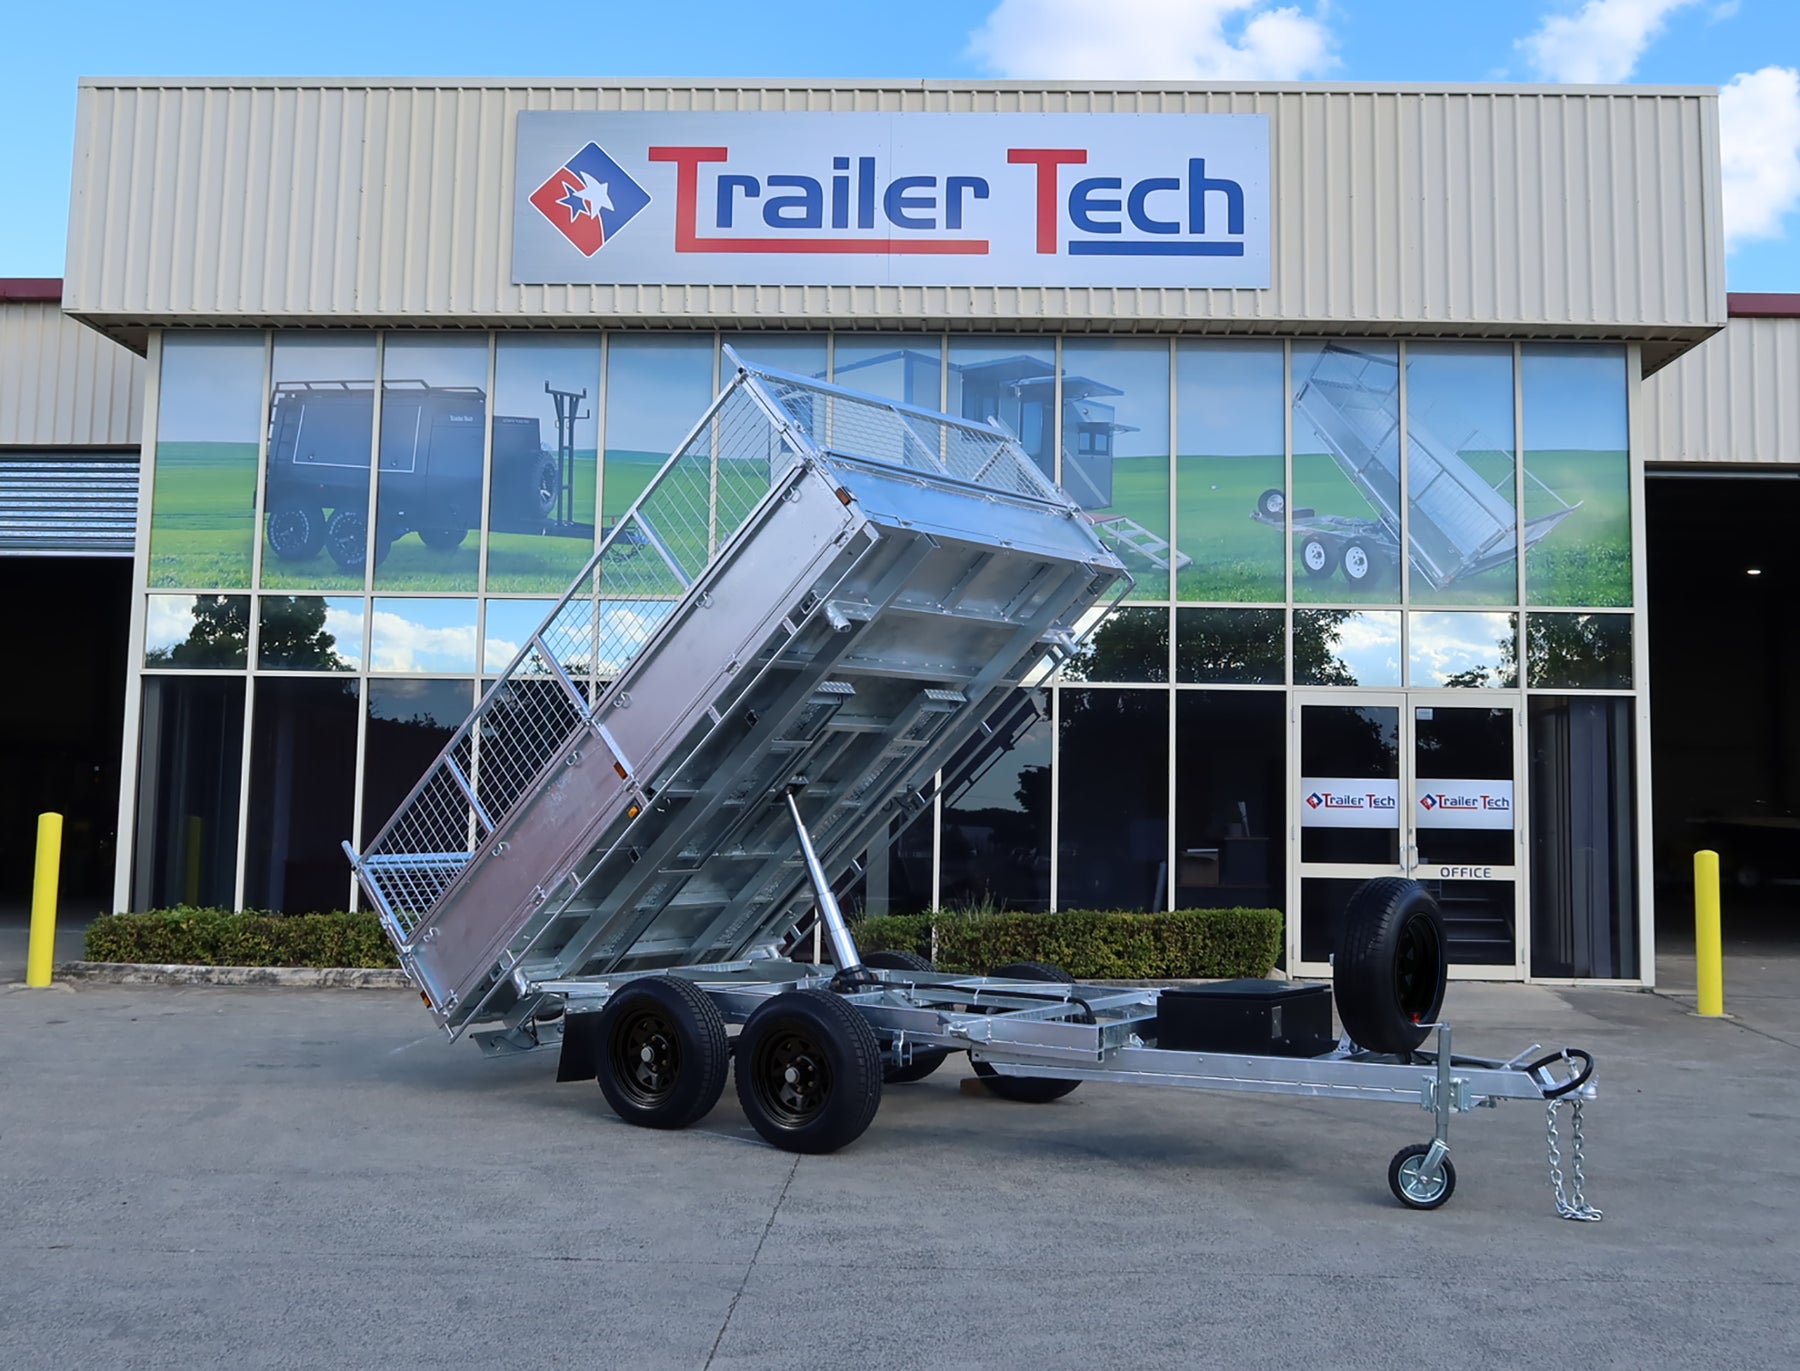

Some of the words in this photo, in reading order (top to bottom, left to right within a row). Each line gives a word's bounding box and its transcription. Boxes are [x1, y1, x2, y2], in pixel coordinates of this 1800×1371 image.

[648, 146, 990, 255] Trailer
[1007, 148, 1245, 256] Tech
[1321, 793, 1364, 808] Trailer
[1366, 794, 1395, 809] Tech
[1436, 794, 1478, 809] Trailer
[1480, 795, 1510, 810] Tech
[1440, 867, 1492, 878] OFFICE
